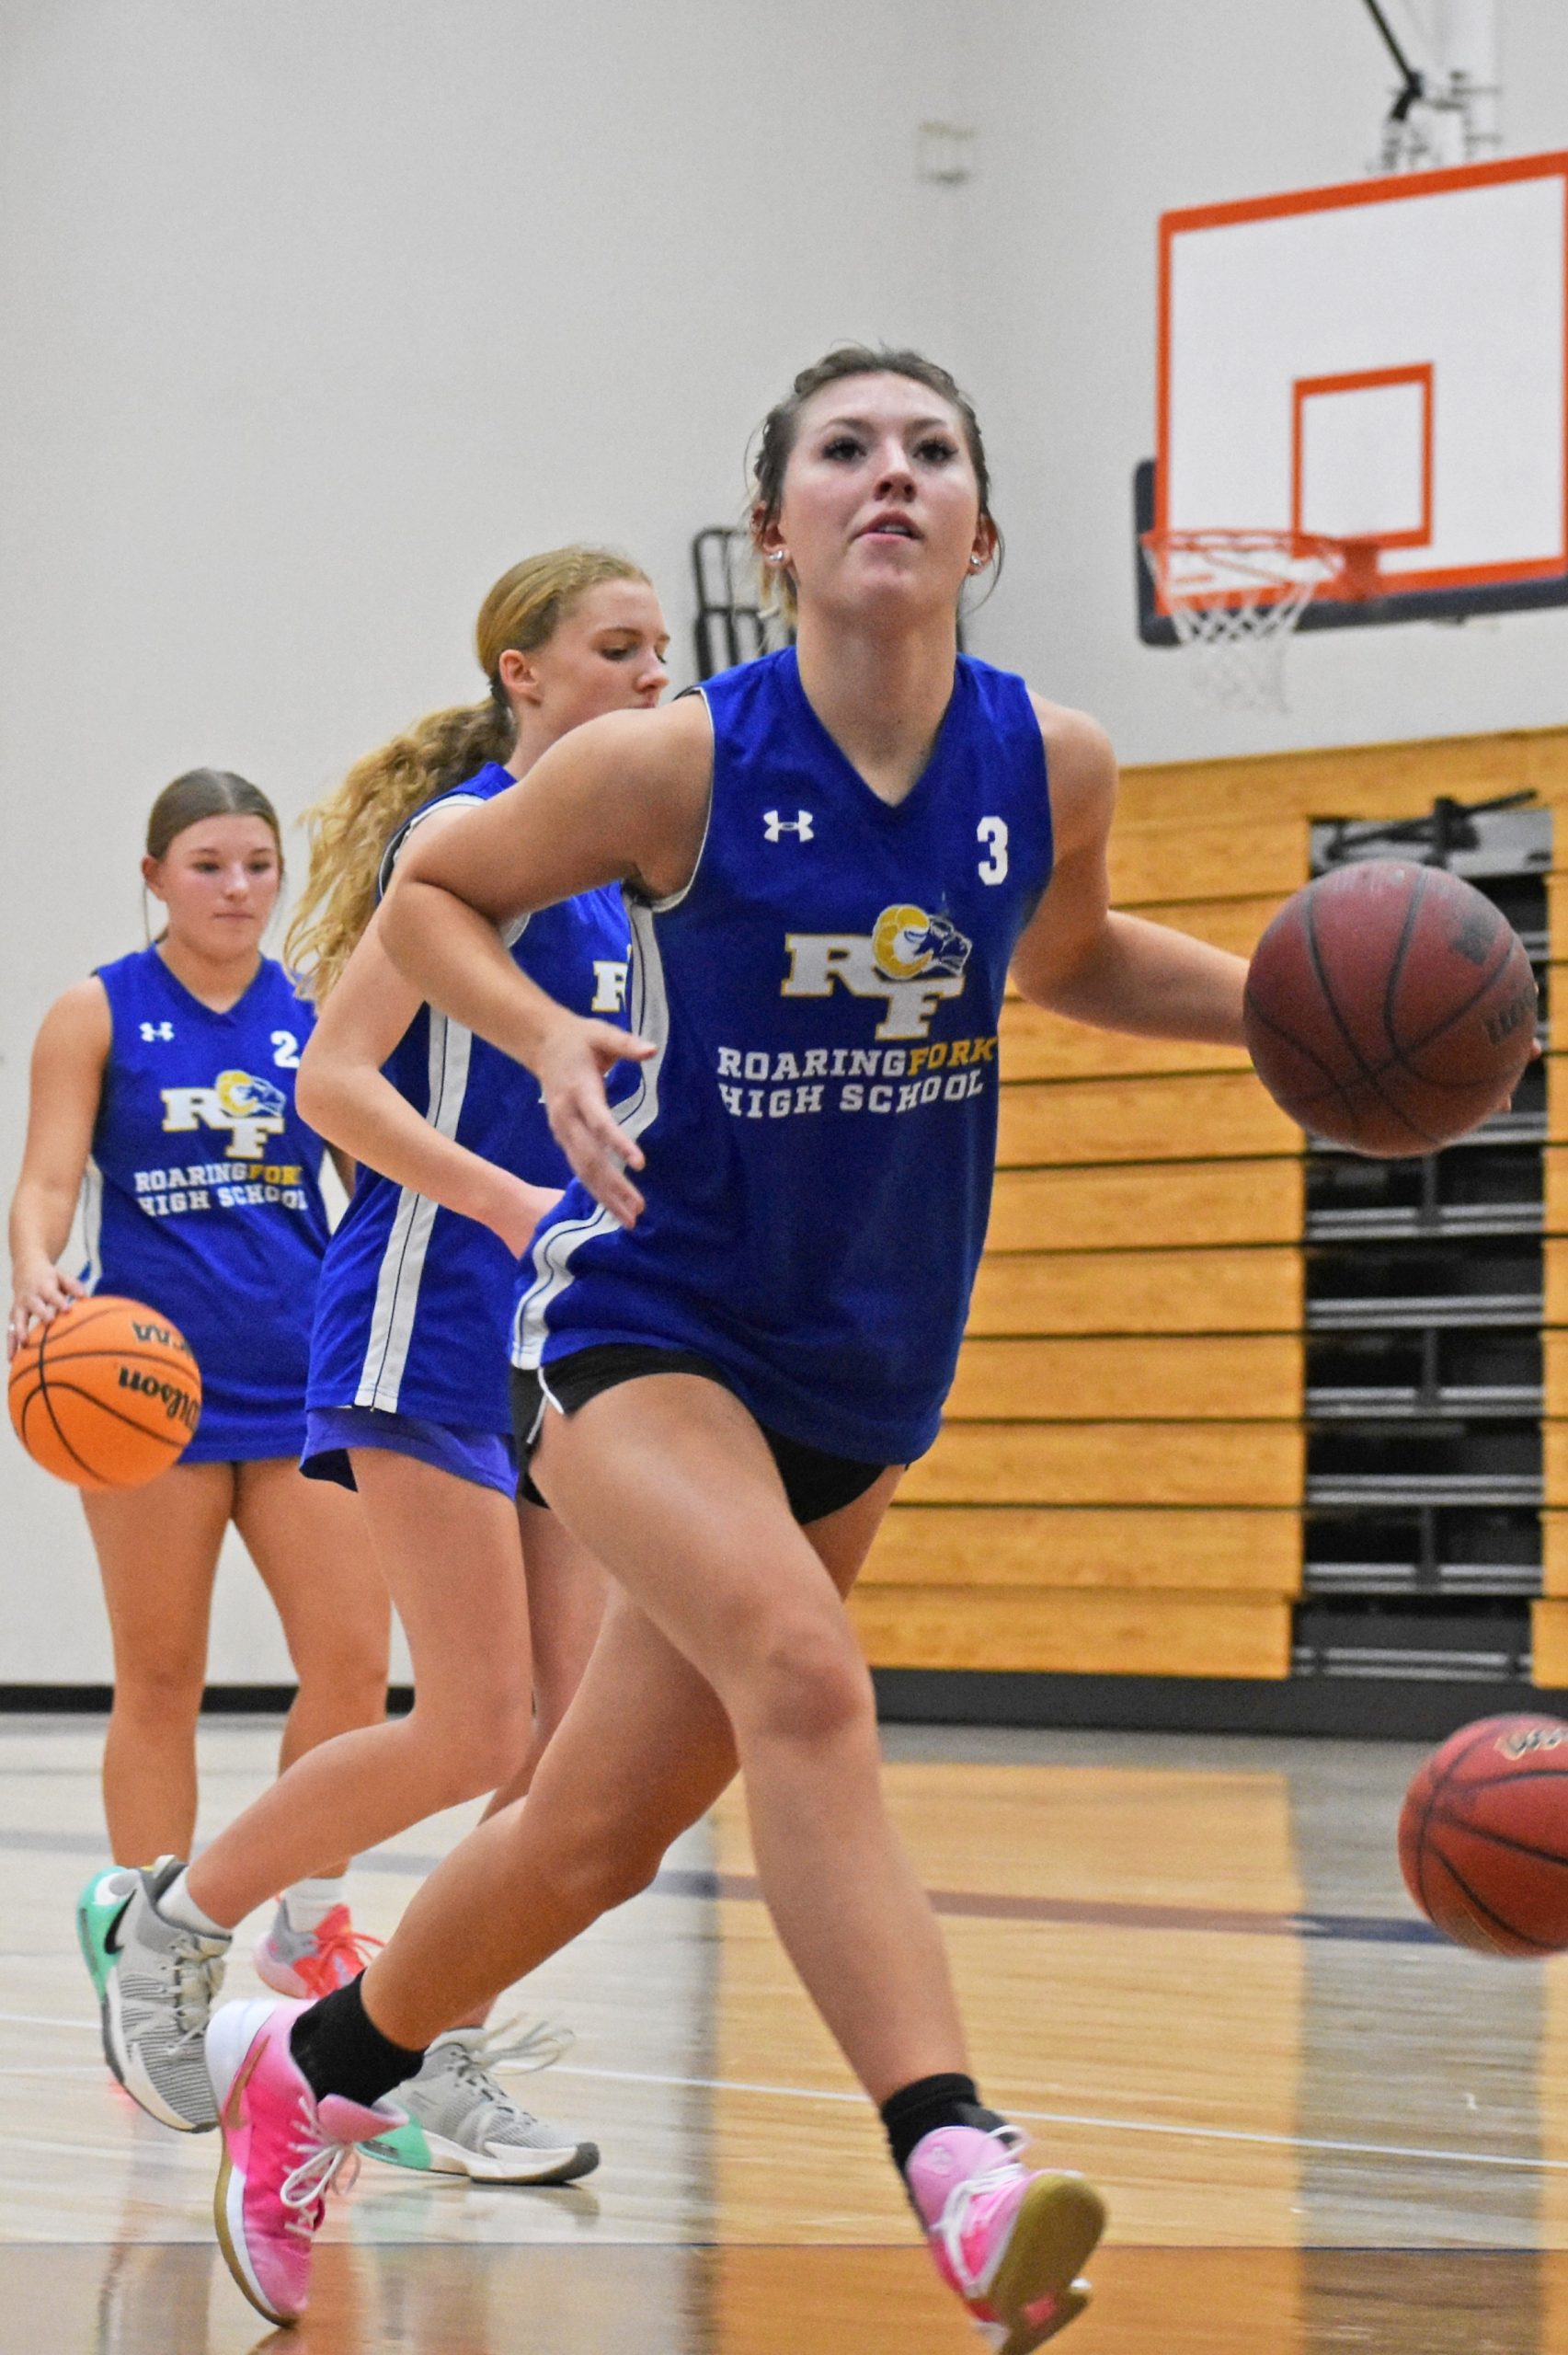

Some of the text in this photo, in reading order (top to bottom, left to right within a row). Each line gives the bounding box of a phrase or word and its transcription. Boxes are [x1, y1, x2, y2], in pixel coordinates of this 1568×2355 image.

[977, 816, 1008, 885] 3
[270, 1030, 301, 1068] 2
[718, 1069, 984, 1118] HIGH SCHOOL
